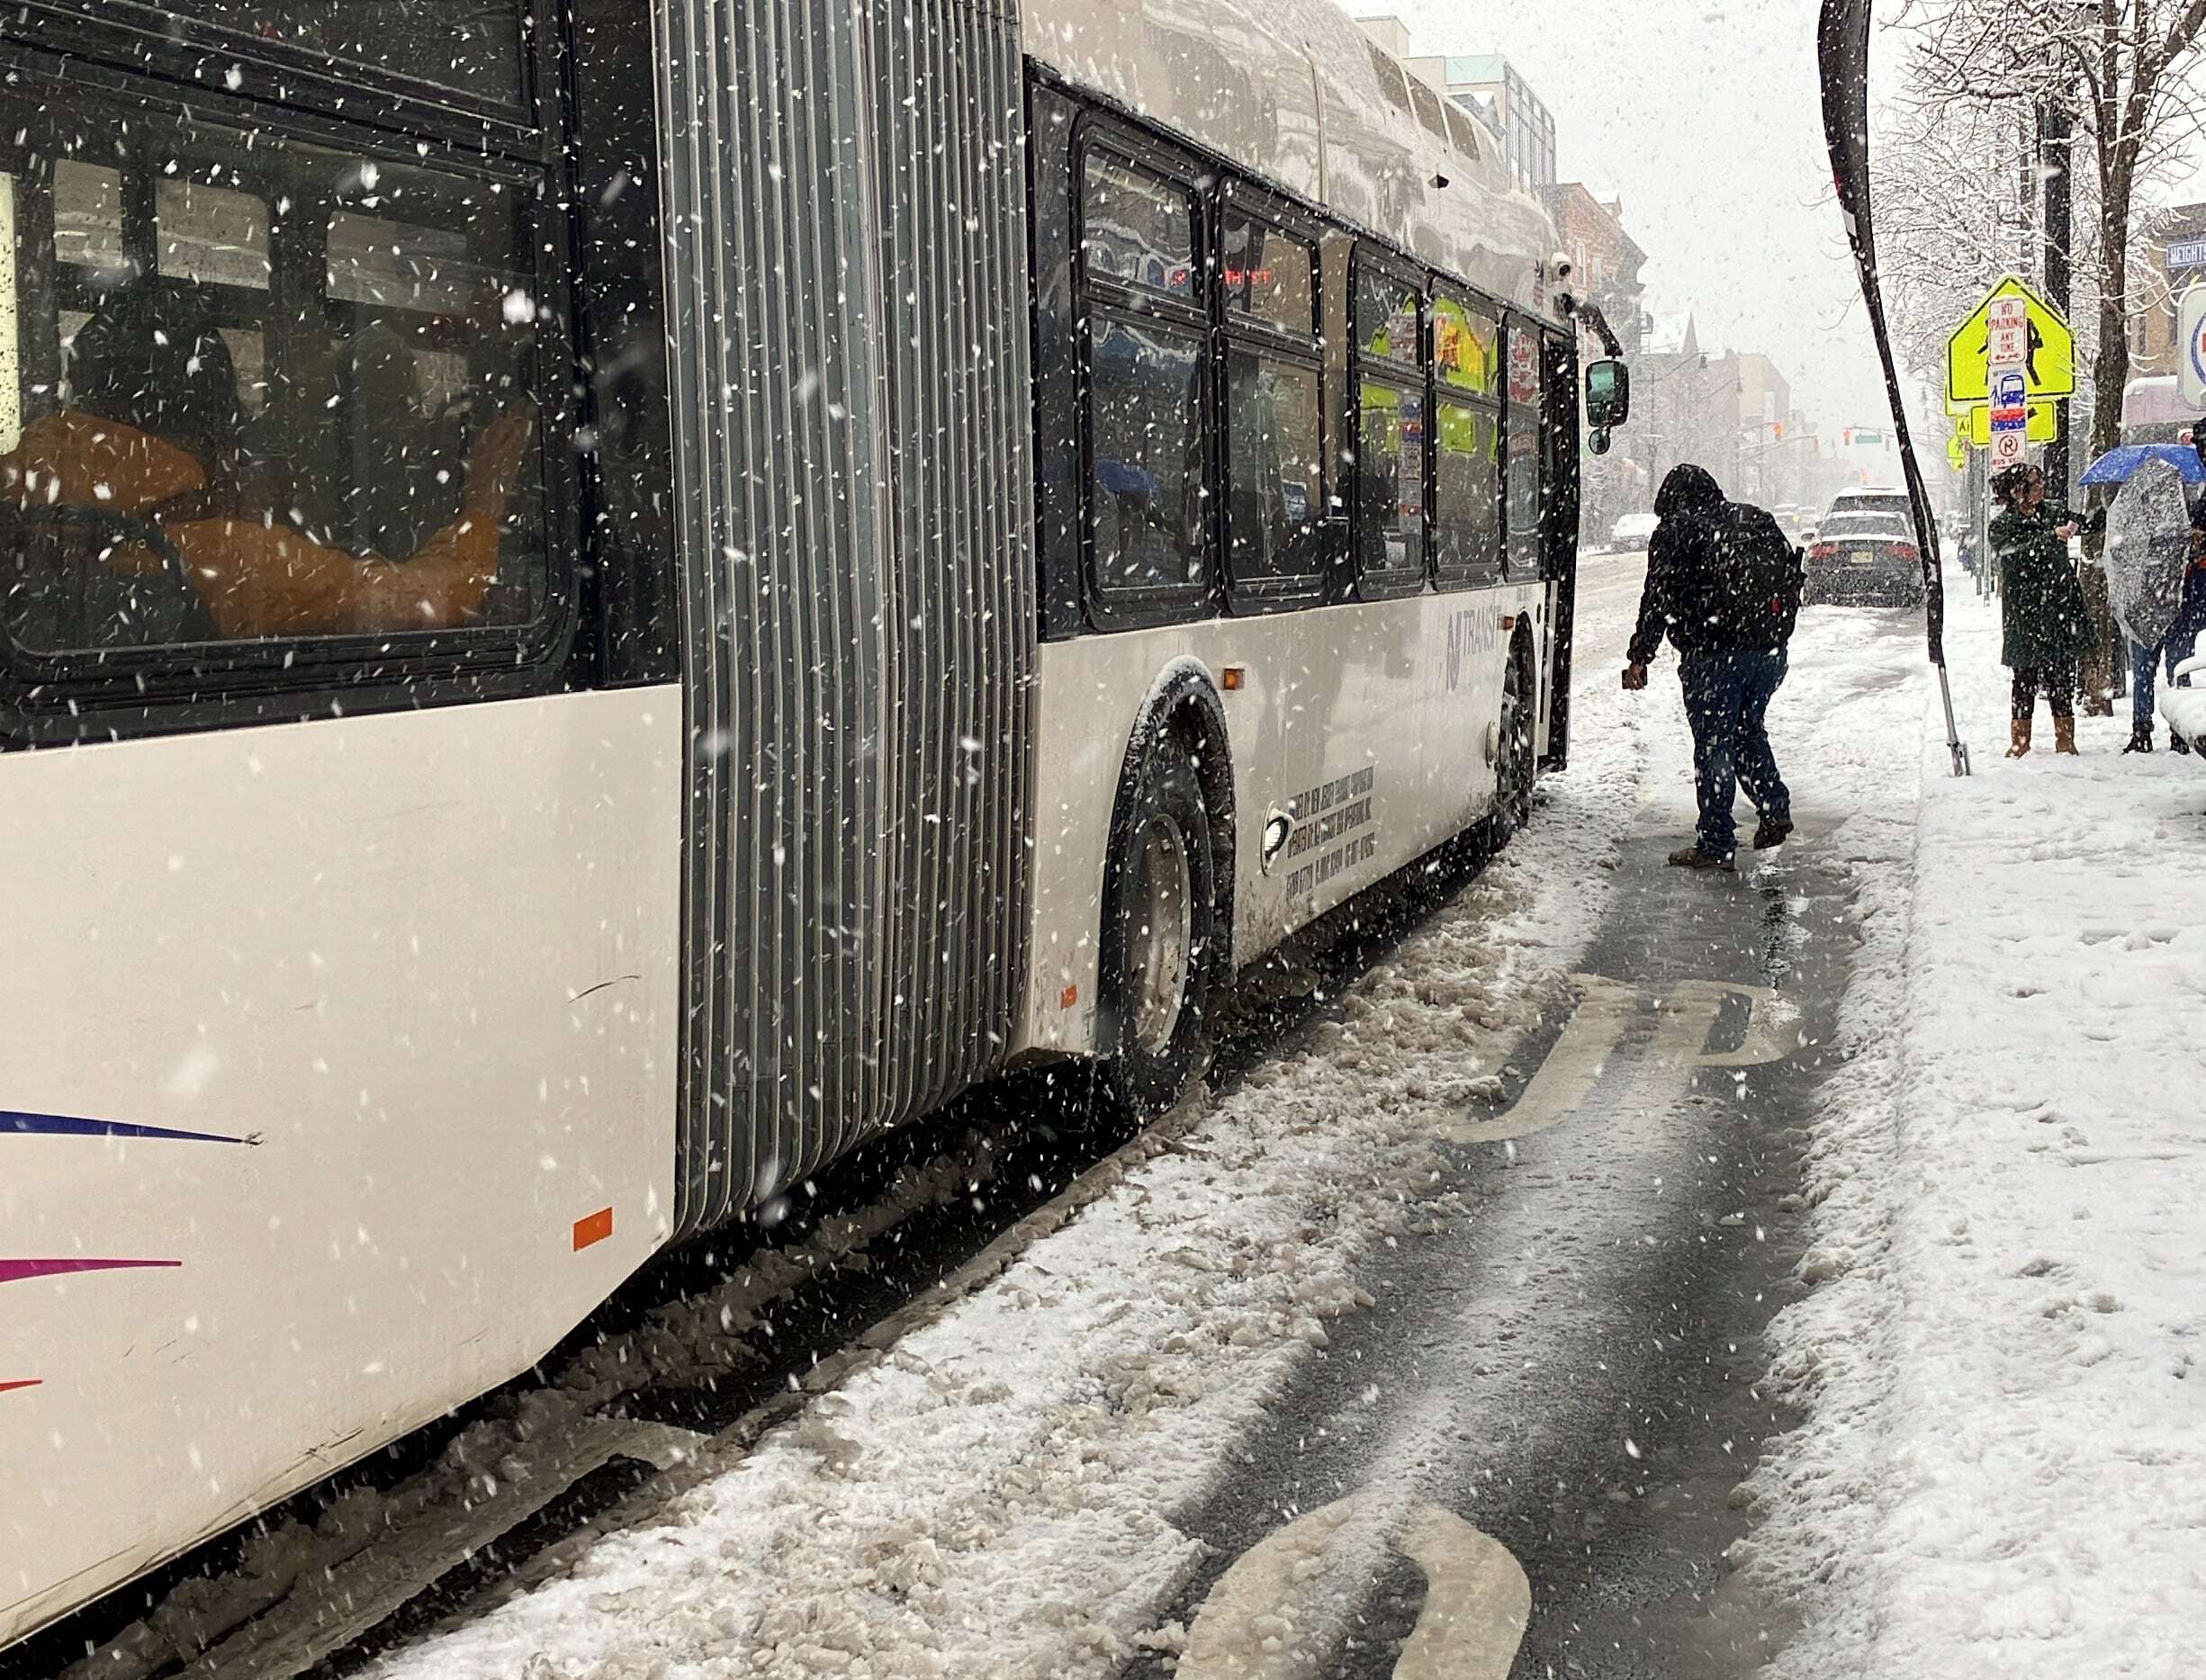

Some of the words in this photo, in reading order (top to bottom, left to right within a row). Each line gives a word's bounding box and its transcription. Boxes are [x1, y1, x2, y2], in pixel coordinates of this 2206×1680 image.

[2001, 302, 2013, 316] NO
[1990, 316, 2023, 331] PARKING
[2000, 331, 2014, 342] ANY
[2000, 342, 2014, 353] TIME
